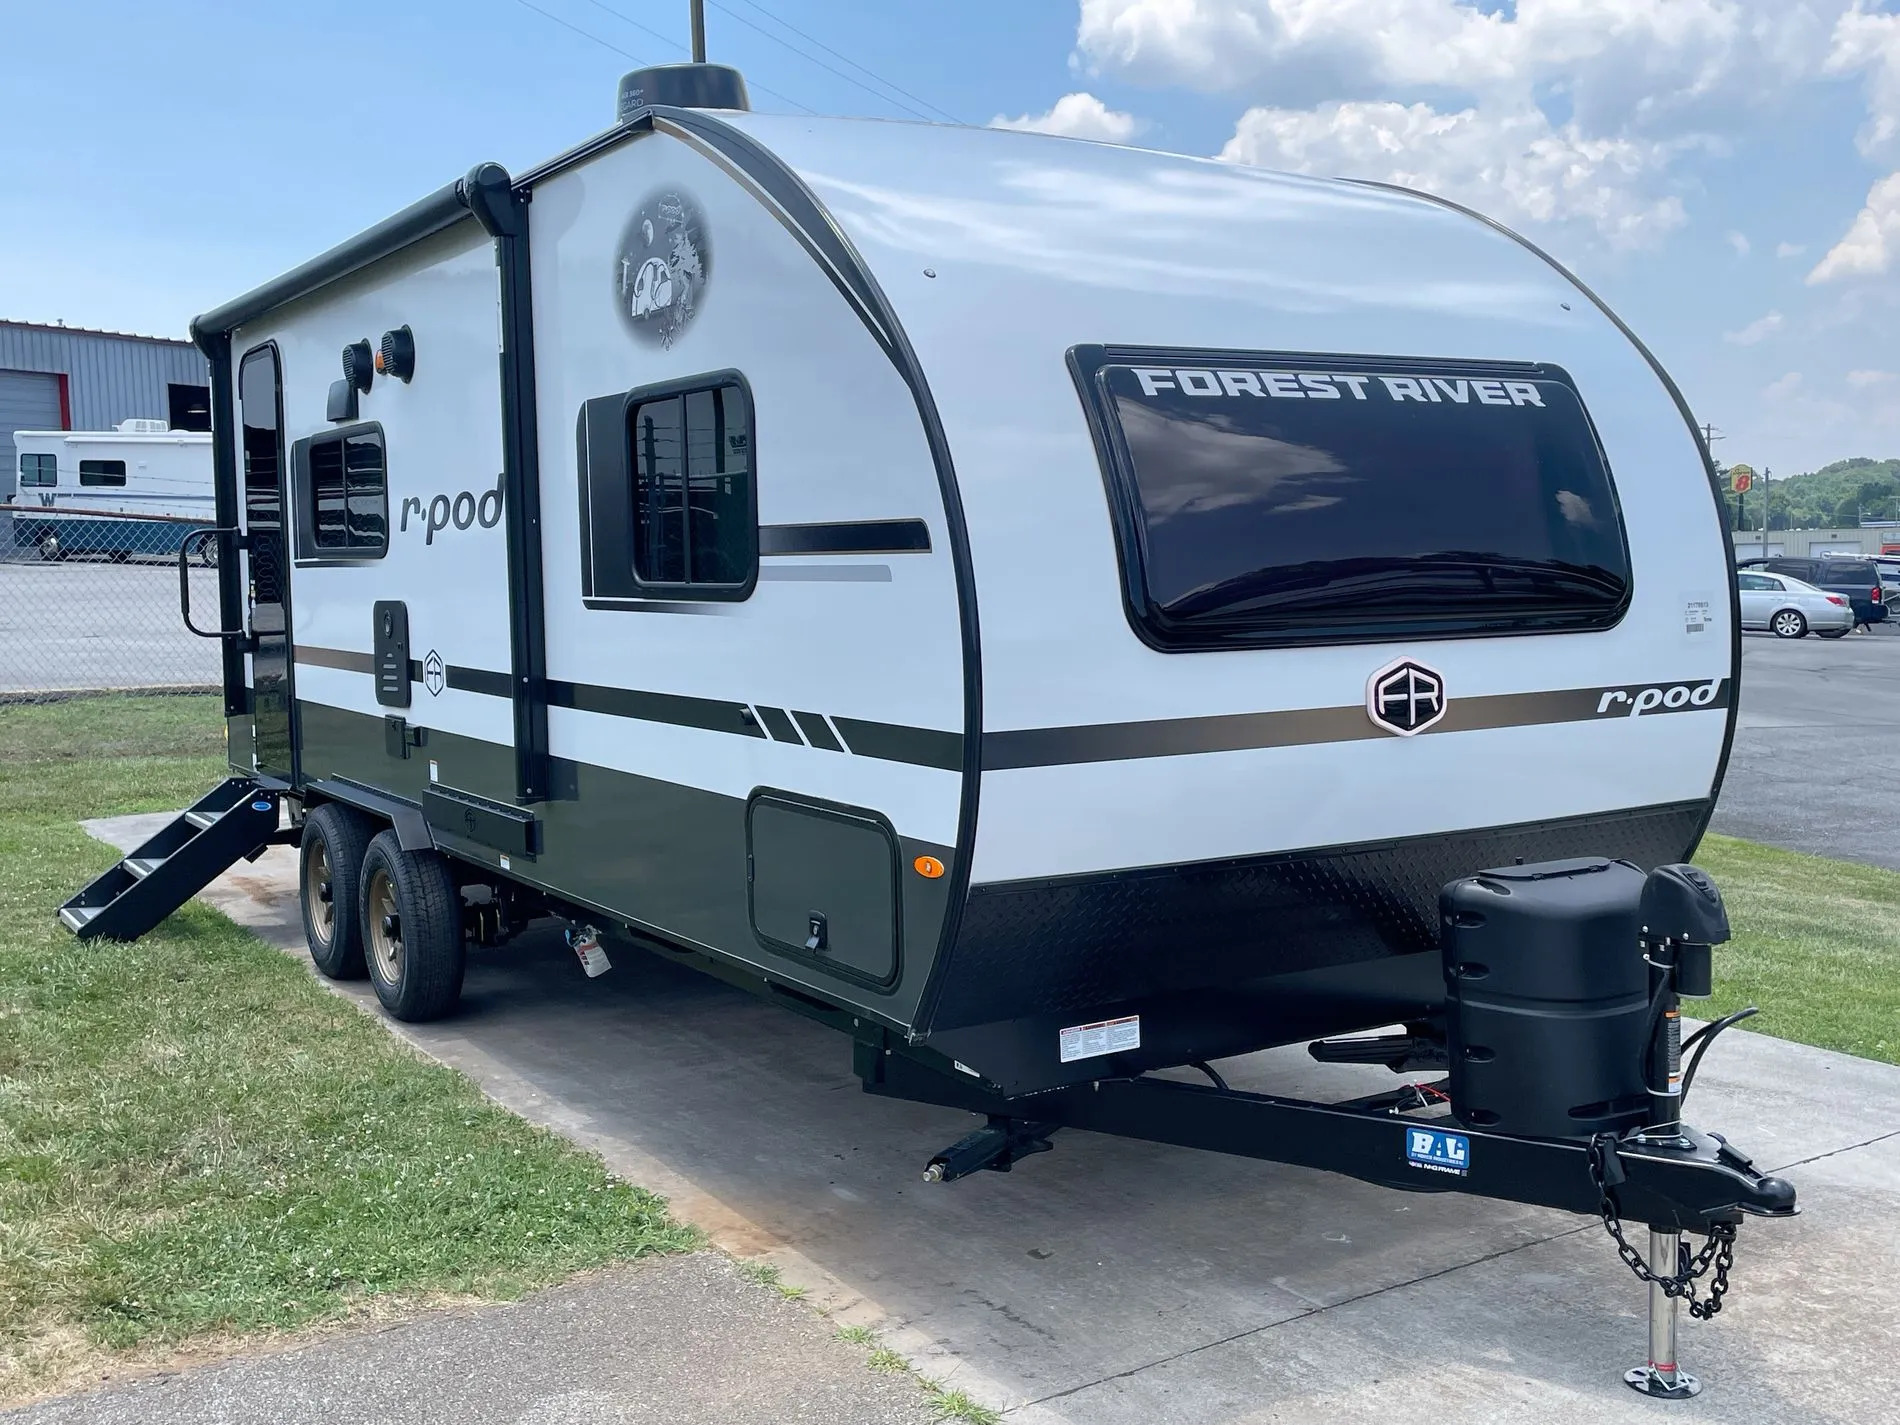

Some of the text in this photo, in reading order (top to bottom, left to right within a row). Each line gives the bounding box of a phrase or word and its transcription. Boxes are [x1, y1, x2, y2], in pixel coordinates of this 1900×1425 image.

[1130, 368, 1546, 408] FOREST RIVER
[1412, 1132, 1465, 1161] BAL
